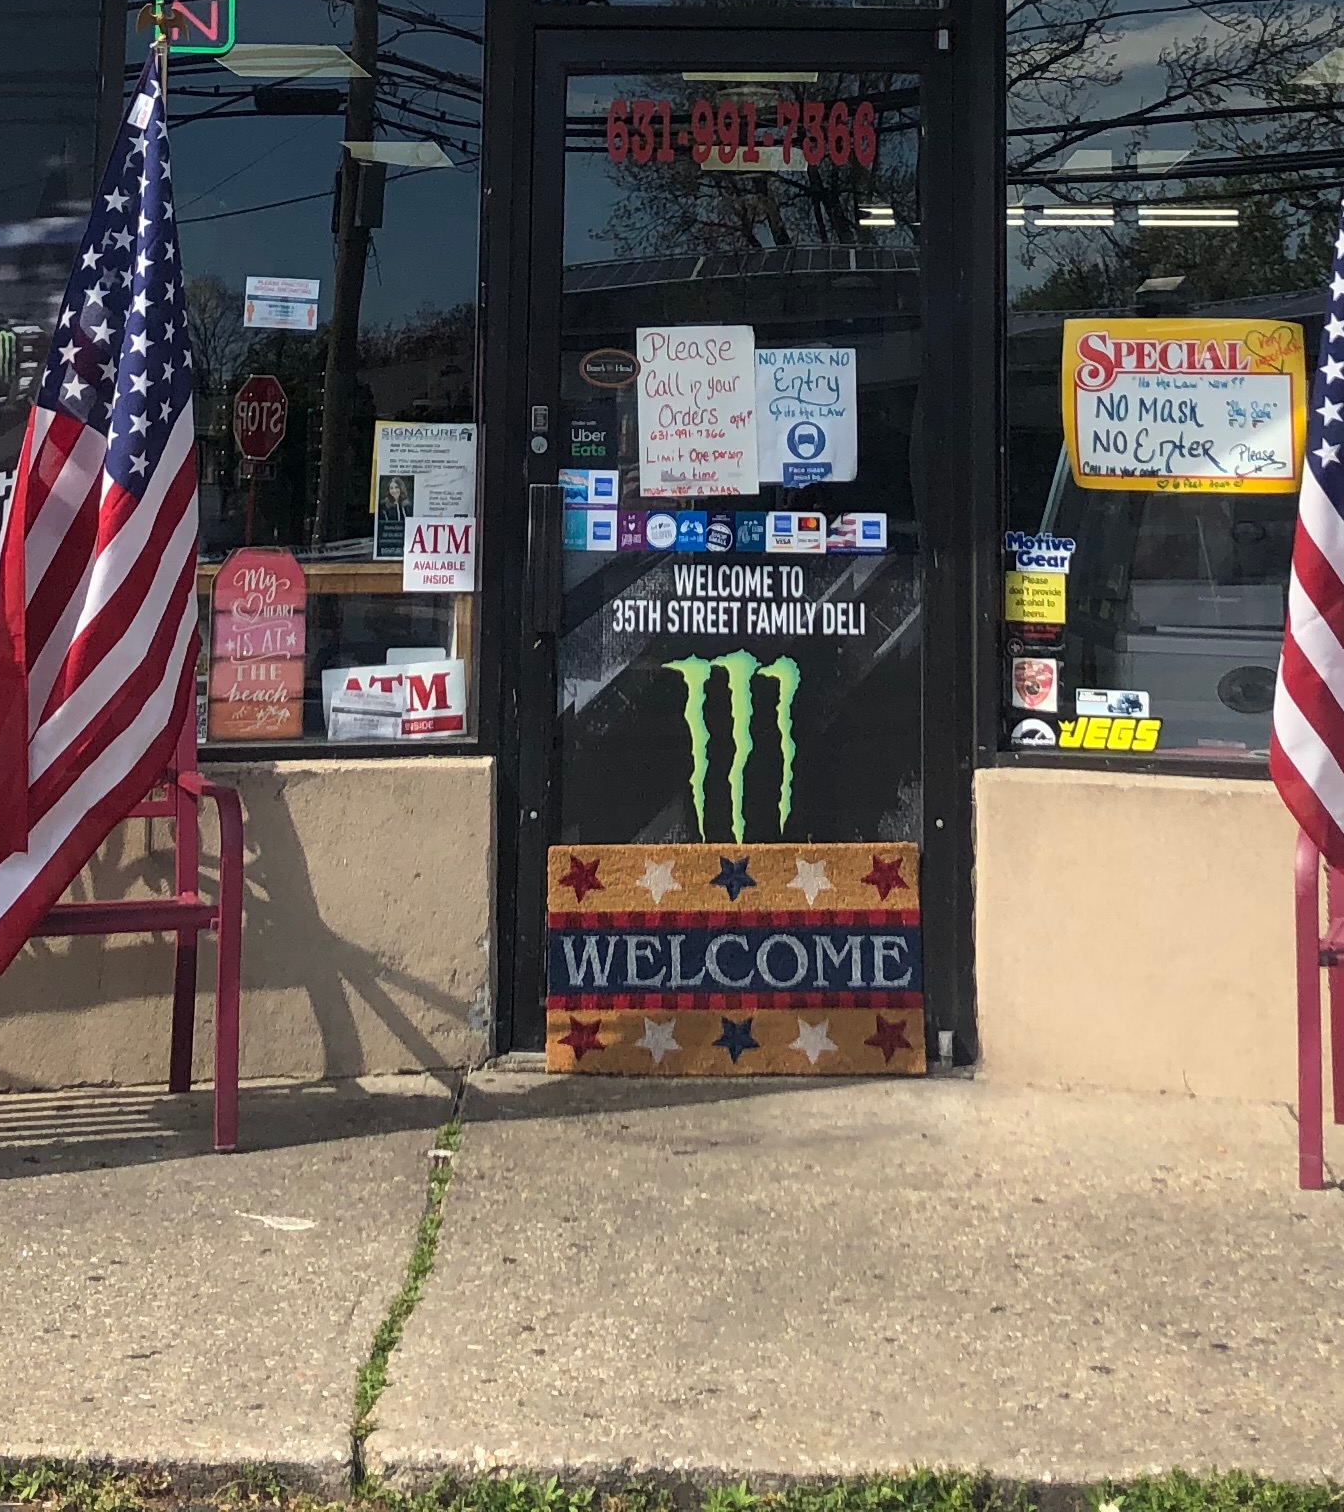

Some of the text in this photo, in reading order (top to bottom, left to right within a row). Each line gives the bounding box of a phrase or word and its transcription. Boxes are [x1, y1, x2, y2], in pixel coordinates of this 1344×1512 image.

[642, 332, 736, 366] Please
[759, 350, 850, 367] NO MASK NO
[1075, 332, 1253, 390] SPECIAL
[645, 369, 685, 399] Call
[707, 375, 741, 400] your
[772, 366, 841, 407] Entry
[658, 403, 719, 428] Orders
[1095, 392, 1129, 422] NO
[381, 427, 458, 437] SIGNATURE
[571, 428, 607, 442] Uber
[650, 428, 727, 441] 631-991-7366
[1092, 428, 1128, 455] NO
[571, 443, 607, 457] Eats
[646, 446, 684, 465] Limit
[1229, 442, 1276, 463] Please
[408, 523, 473, 555] ATM
[1006, 532, 1074, 552] Motive
[413, 560, 466, 572] AVAILABLE
[1017, 550, 1068, 568] Gear
[233, 566, 291, 604] My
[422, 574, 456, 586] INSIDE
[674, 564, 804, 598] WELCOME TO
[612, 599, 866, 637] 35TH STREET FAMILY DELI
[236, 627, 288, 659] IS AT
[231, 663, 283, 682] THE
[224, 682, 290, 703] beach
[1058, 716, 1162, 753] JEGS
[560, 933, 914, 988] WELCOME
